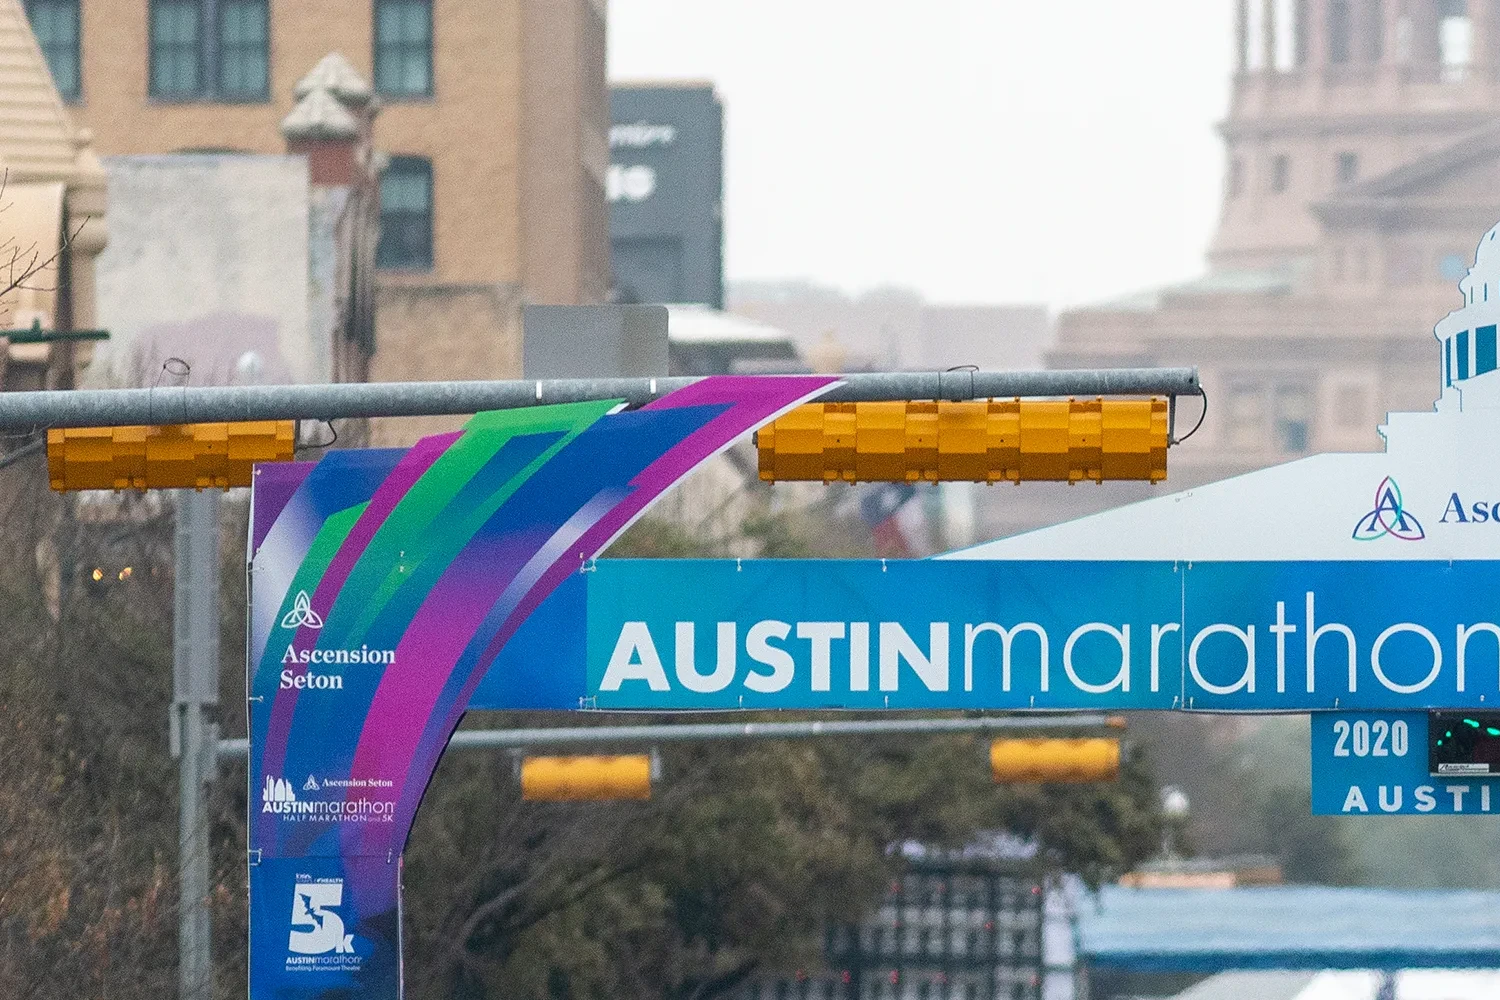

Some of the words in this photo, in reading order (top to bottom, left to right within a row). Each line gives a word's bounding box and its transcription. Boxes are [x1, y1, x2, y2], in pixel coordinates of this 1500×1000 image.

[281, 644, 396, 664] Ascension
[280, 669, 343, 689] Seton
[1333, 719, 1408, 757] 2020
[322, 778, 367, 787] Ascension
[368, 779, 393, 787] Seton
[283, 814, 305, 822] HALF
[309, 814, 367, 822] MARATHON
